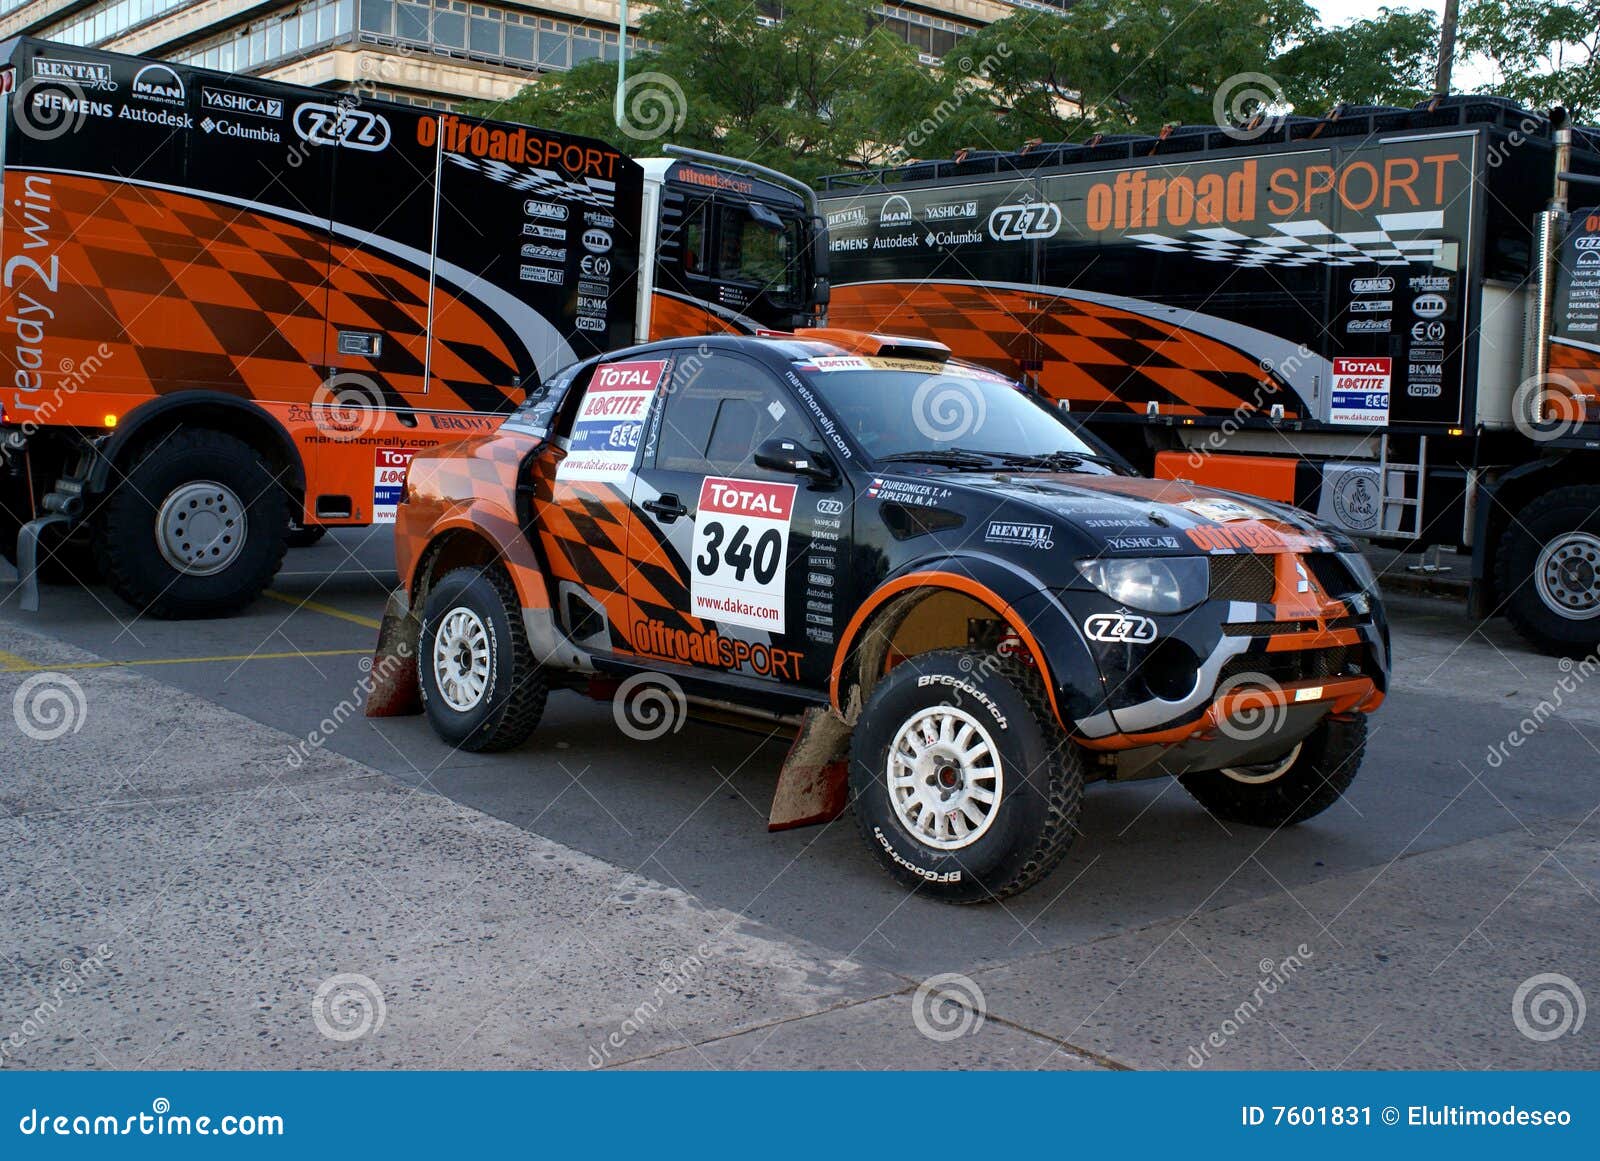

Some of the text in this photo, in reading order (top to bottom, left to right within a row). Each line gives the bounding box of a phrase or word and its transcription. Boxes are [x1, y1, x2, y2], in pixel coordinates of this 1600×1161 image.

[36, 61, 110, 81] RENTAL
[90, 79, 119, 92] PRO
[136, 82, 181, 98] MAN
[33, 92, 113, 118] SIEMENS
[203, 90, 267, 115] YASHICA
[118, 104, 194, 129] Autodesk
[216, 119, 281, 143] Columbia
[1086, 152, 1460, 232] offroad SPORT
[829, 209, 864, 225] RENTAL
[881, 211, 910, 222] MAN
[926, 204, 968, 219] YASHICA
[872, 233, 919, 249] Autodesk
[935, 228, 983, 246] Columbia
[547, 269, 563, 285] CAT
[1338, 360, 1386, 373] TOTAL
[599, 367, 652, 387] TOTAL
[1336, 377, 1385, 390] LOCTITE
[584, 395, 647, 417] LOCTITE
[784, 369, 854, 460] marathonrally.com
[1333, 413, 1386, 422] www.dakar.com
[304, 435, 440, 449] marathonrally.com
[381, 450, 413, 465] TOT
[882, 480, 932, 496] OUREDNICEK
[710, 483, 783, 514] TOTAL
[877, 489, 913, 504] ZAPLETAL
[1085, 518, 1150, 529] SIEMENS
[989, 523, 1050, 541] RENTAL
[1029, 537, 1055, 550] PRO
[1107, 537, 1167, 549] YASHICA
[696, 520, 783, 586] 340
[696, 594, 780, 621] www.dakar.com
[917, 674, 1010, 730] BFGoodrich
[873, 826, 963, 883] BFGoodrich
